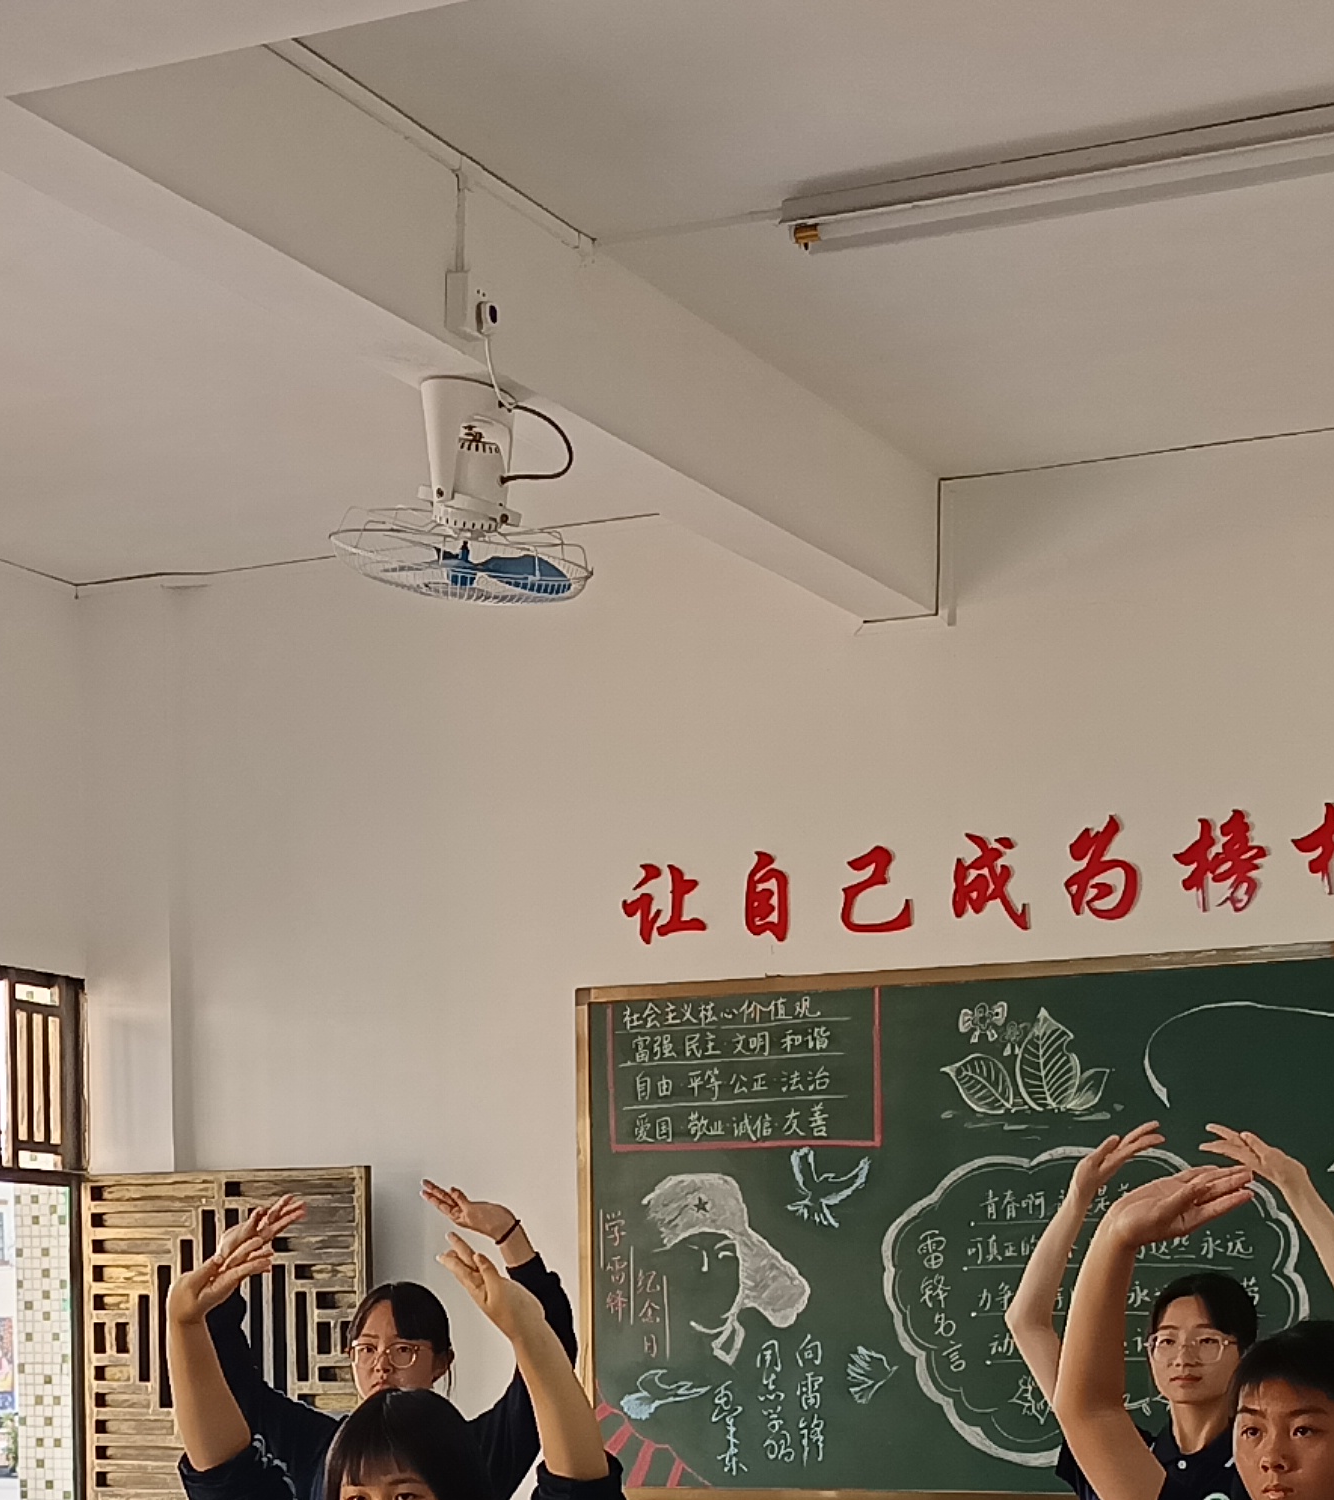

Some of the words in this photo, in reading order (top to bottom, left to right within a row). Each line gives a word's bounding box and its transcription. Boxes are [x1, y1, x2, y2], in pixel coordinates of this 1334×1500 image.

[622, 996, 822, 1030] 社会主义核心价值观
[636, 1268, 661, 1358] 纪念日
